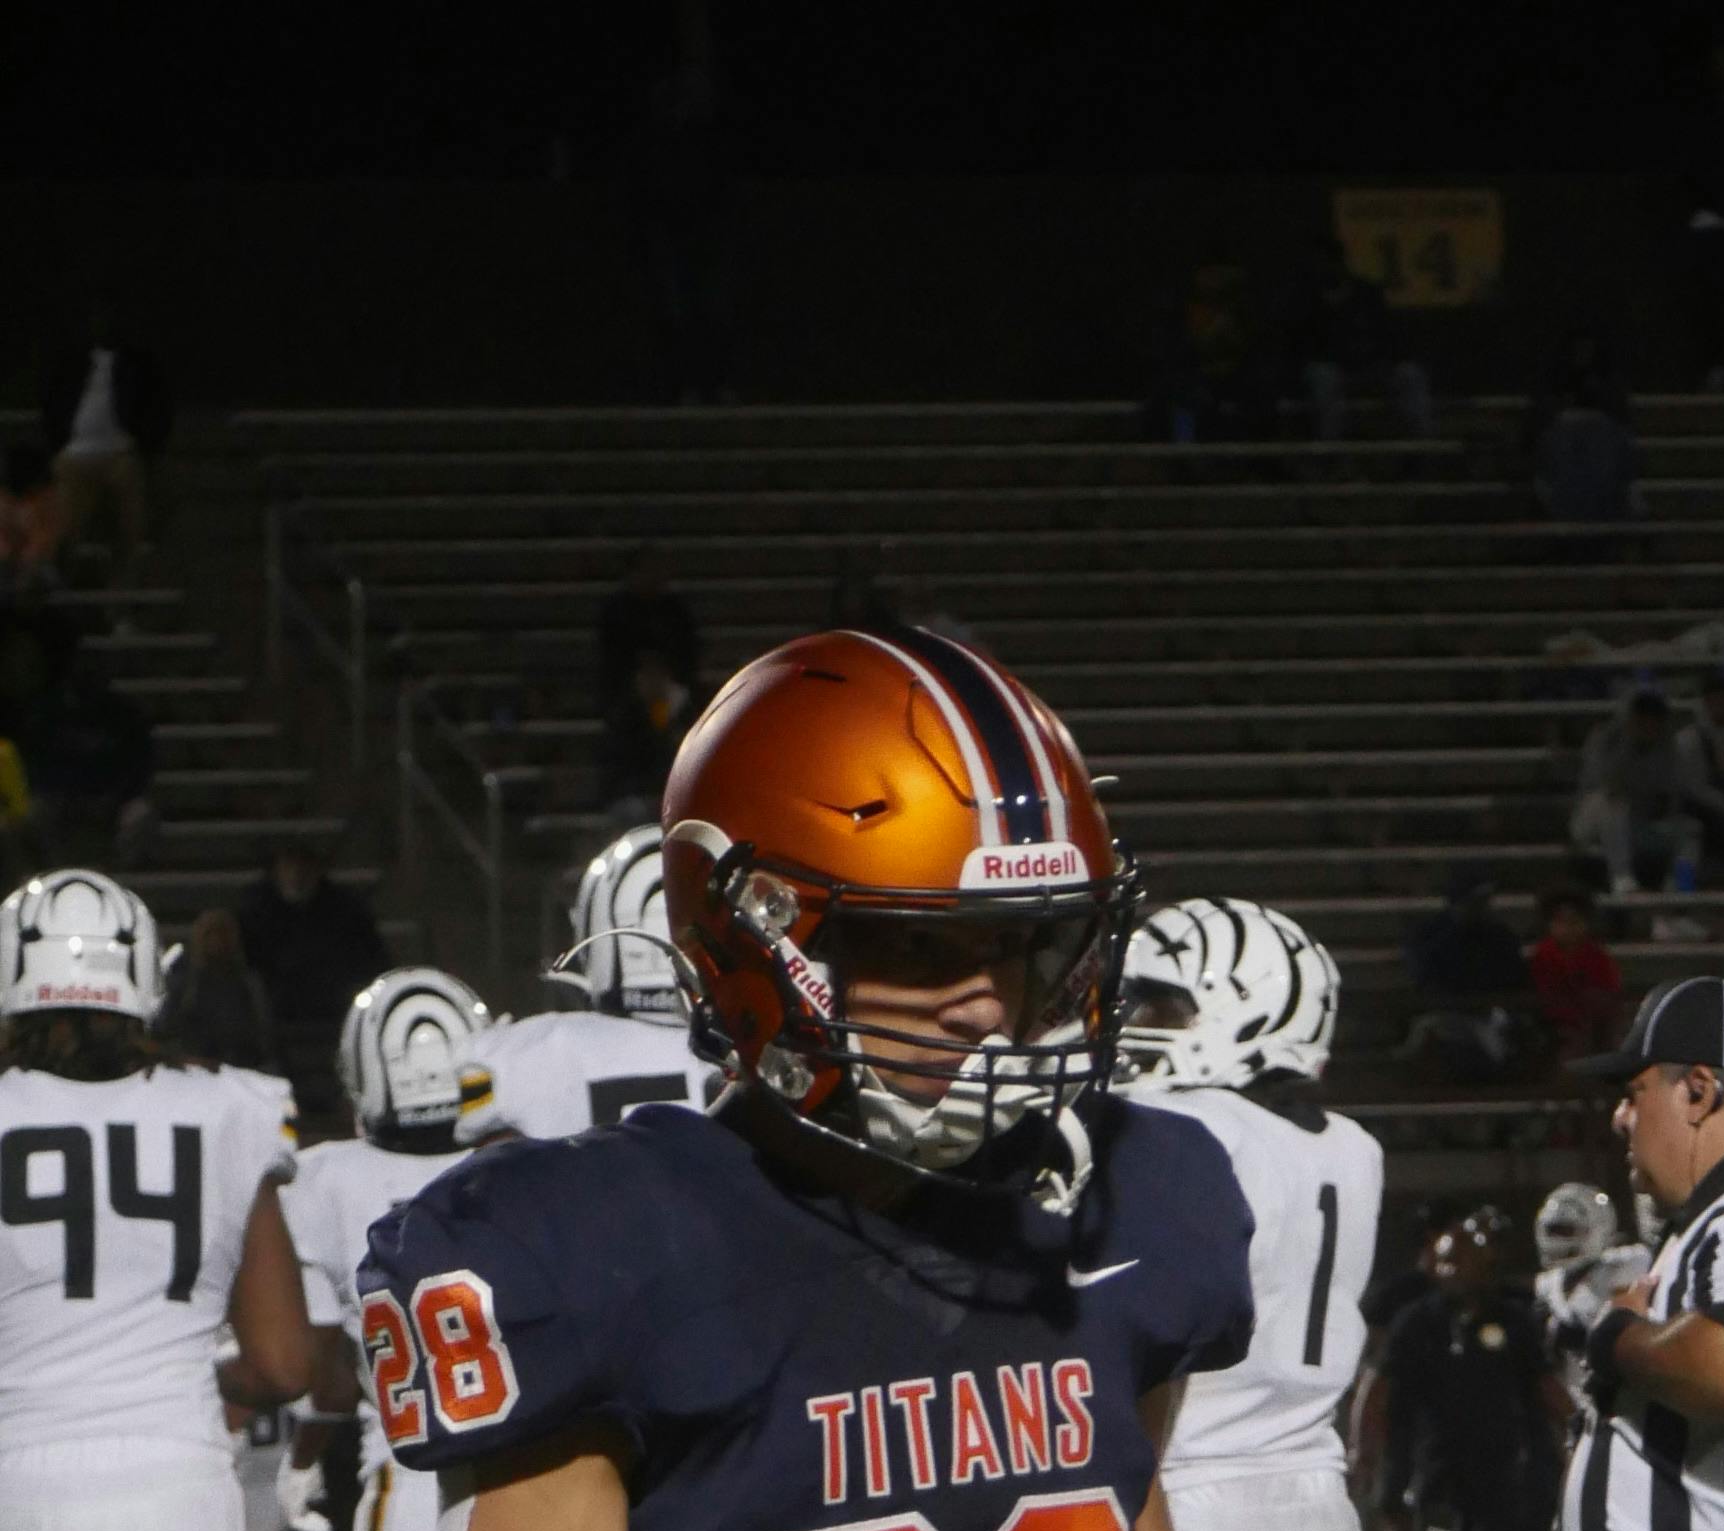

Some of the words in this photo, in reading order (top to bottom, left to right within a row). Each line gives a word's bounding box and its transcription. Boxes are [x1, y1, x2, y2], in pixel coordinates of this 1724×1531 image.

[983, 849, 1076, 879] Riddell
[784, 955, 834, 1020] Ridd
[0, 1121, 203, 1303] 94
[1302, 1183, 1337, 1366] 1
[361, 1268, 520, 1448] 28
[807, 1358, 1095, 1505] TITANS
